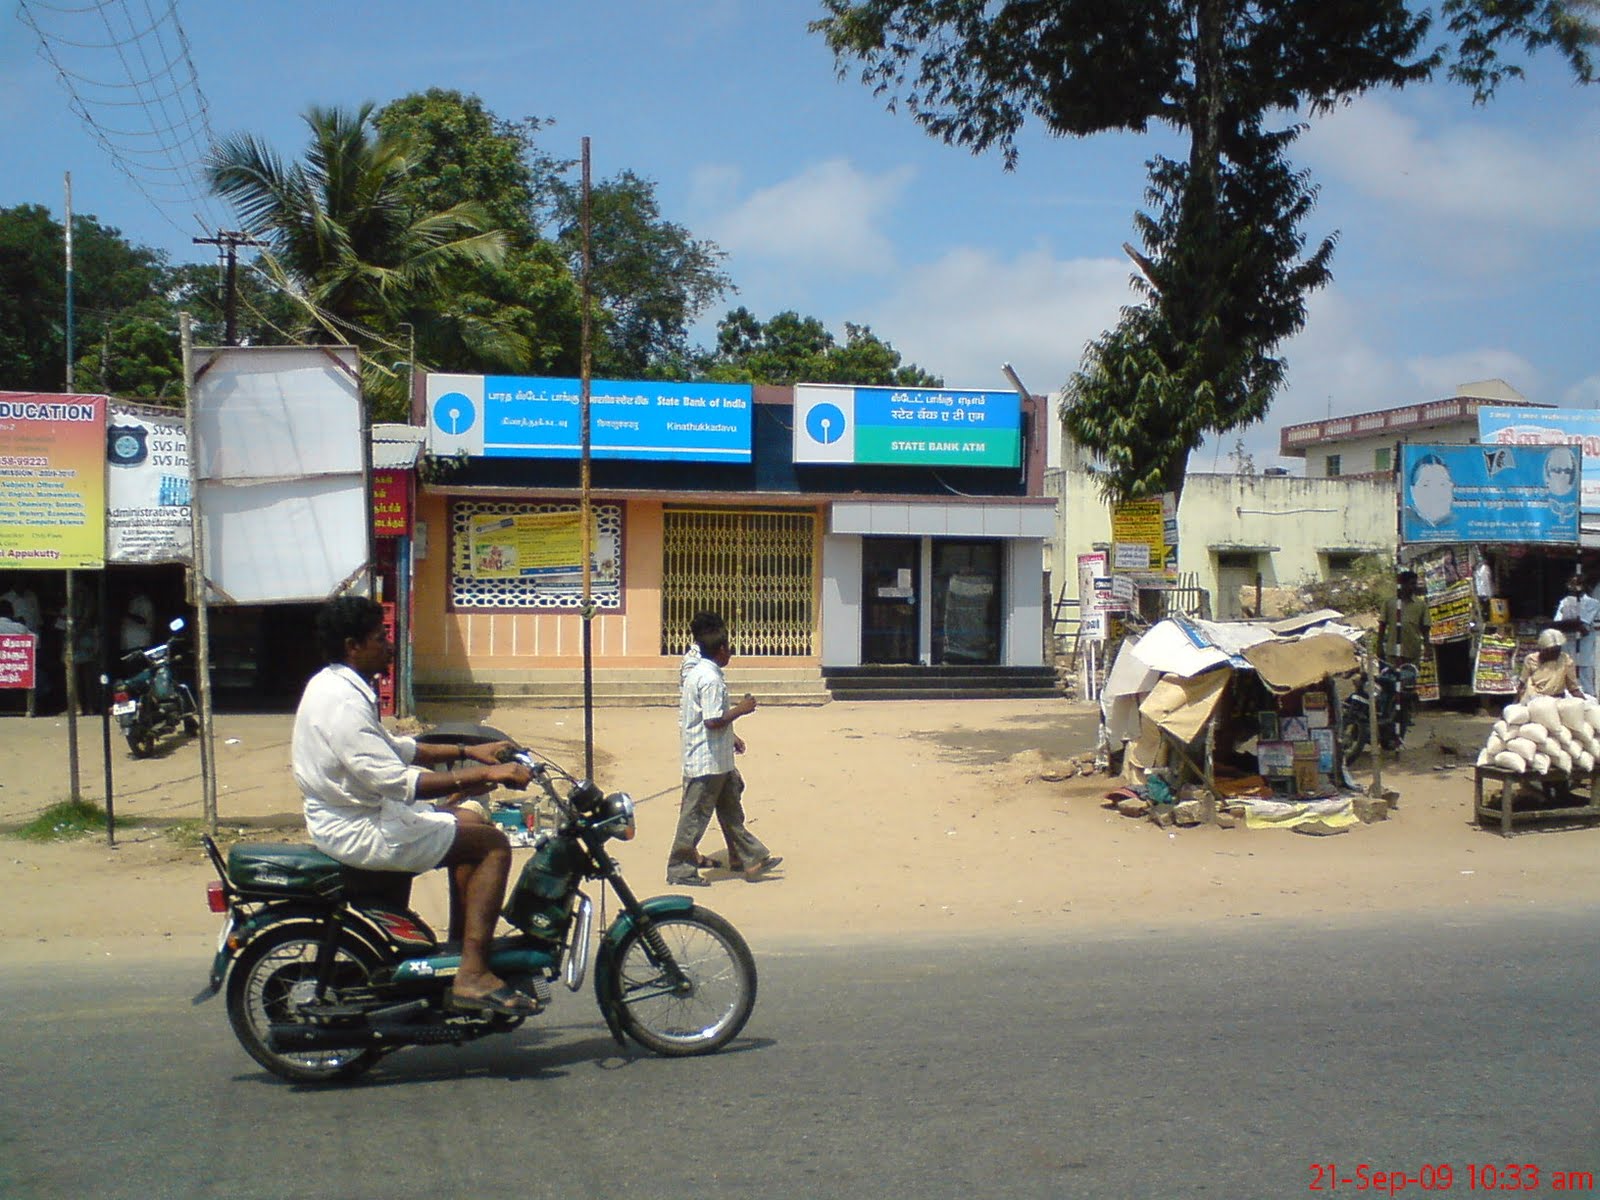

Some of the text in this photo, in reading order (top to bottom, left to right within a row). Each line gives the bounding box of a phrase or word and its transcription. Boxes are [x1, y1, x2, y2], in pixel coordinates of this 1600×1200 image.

[656, 395, 746, 410] State Bank of India
[152, 424, 173, 436] SVS
[152, 441, 173, 452] SVS
[891, 441, 986, 452] STATE BANK ATM
[152, 455, 173, 466] SVS
[7, 549, 61, 561] Appukutty
